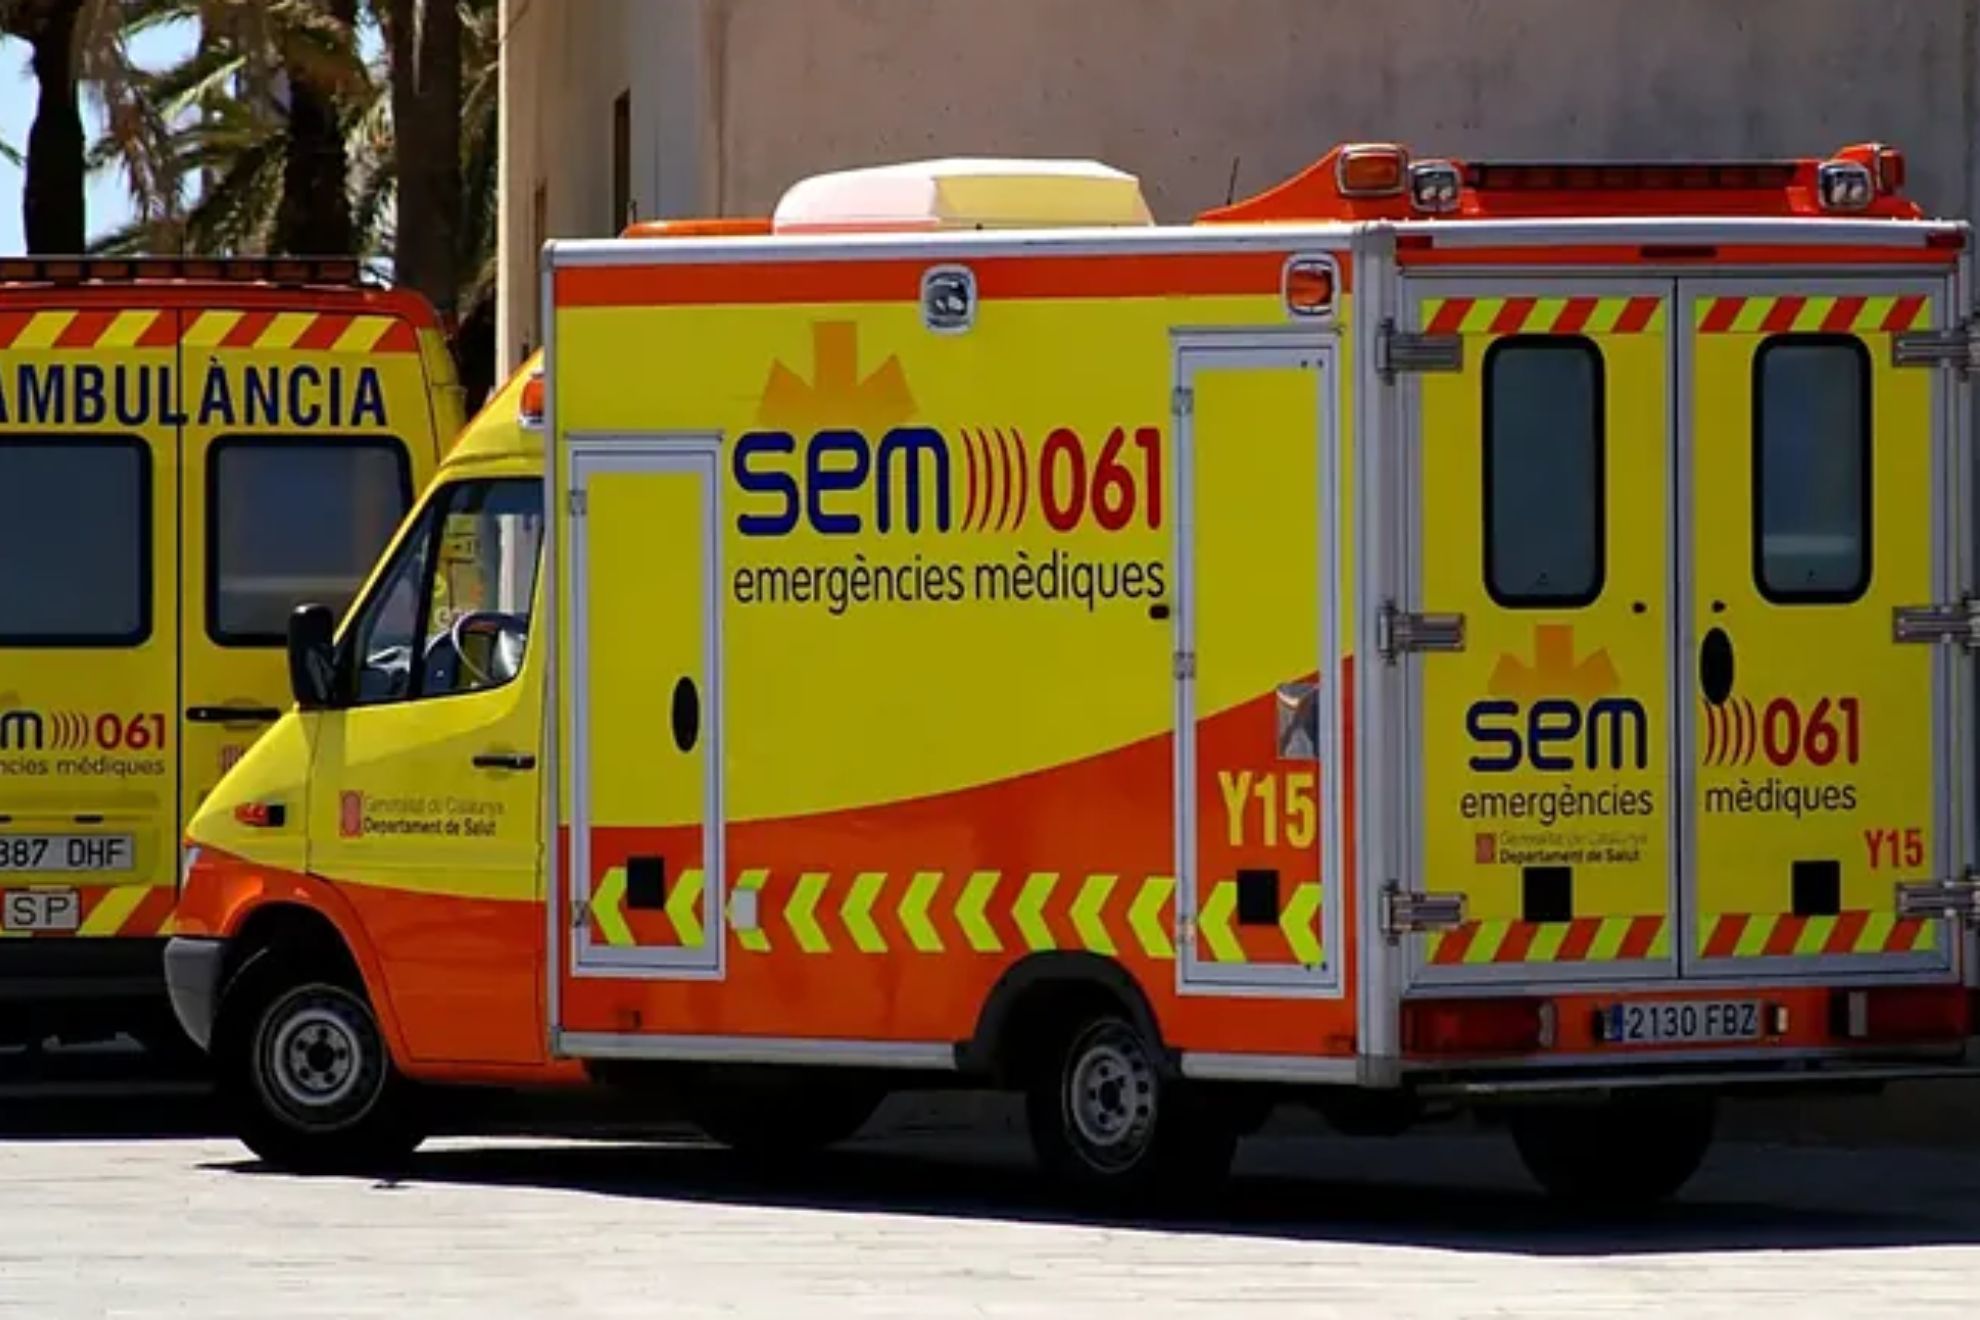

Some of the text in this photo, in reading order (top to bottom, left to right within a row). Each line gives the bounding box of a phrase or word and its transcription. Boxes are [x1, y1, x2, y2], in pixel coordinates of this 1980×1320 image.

[733, 427, 1162, 536] sem 061
[734, 549, 1166, 616] emergències mèdiques
[95, 713, 165, 750] 061
[1466, 697, 1860, 772] sem 061
[1217, 770, 1317, 849] Y15
[1461, 778, 1857, 828] emergències mèdiques
[364, 816, 496, 837] Departament de Salut
[68, 838, 124, 868] DHF
[1500, 848, 1583, 864] Departament
[1864, 828, 1924, 871] Y15
[1627, 1003, 1757, 1040] 2130 FBZ
